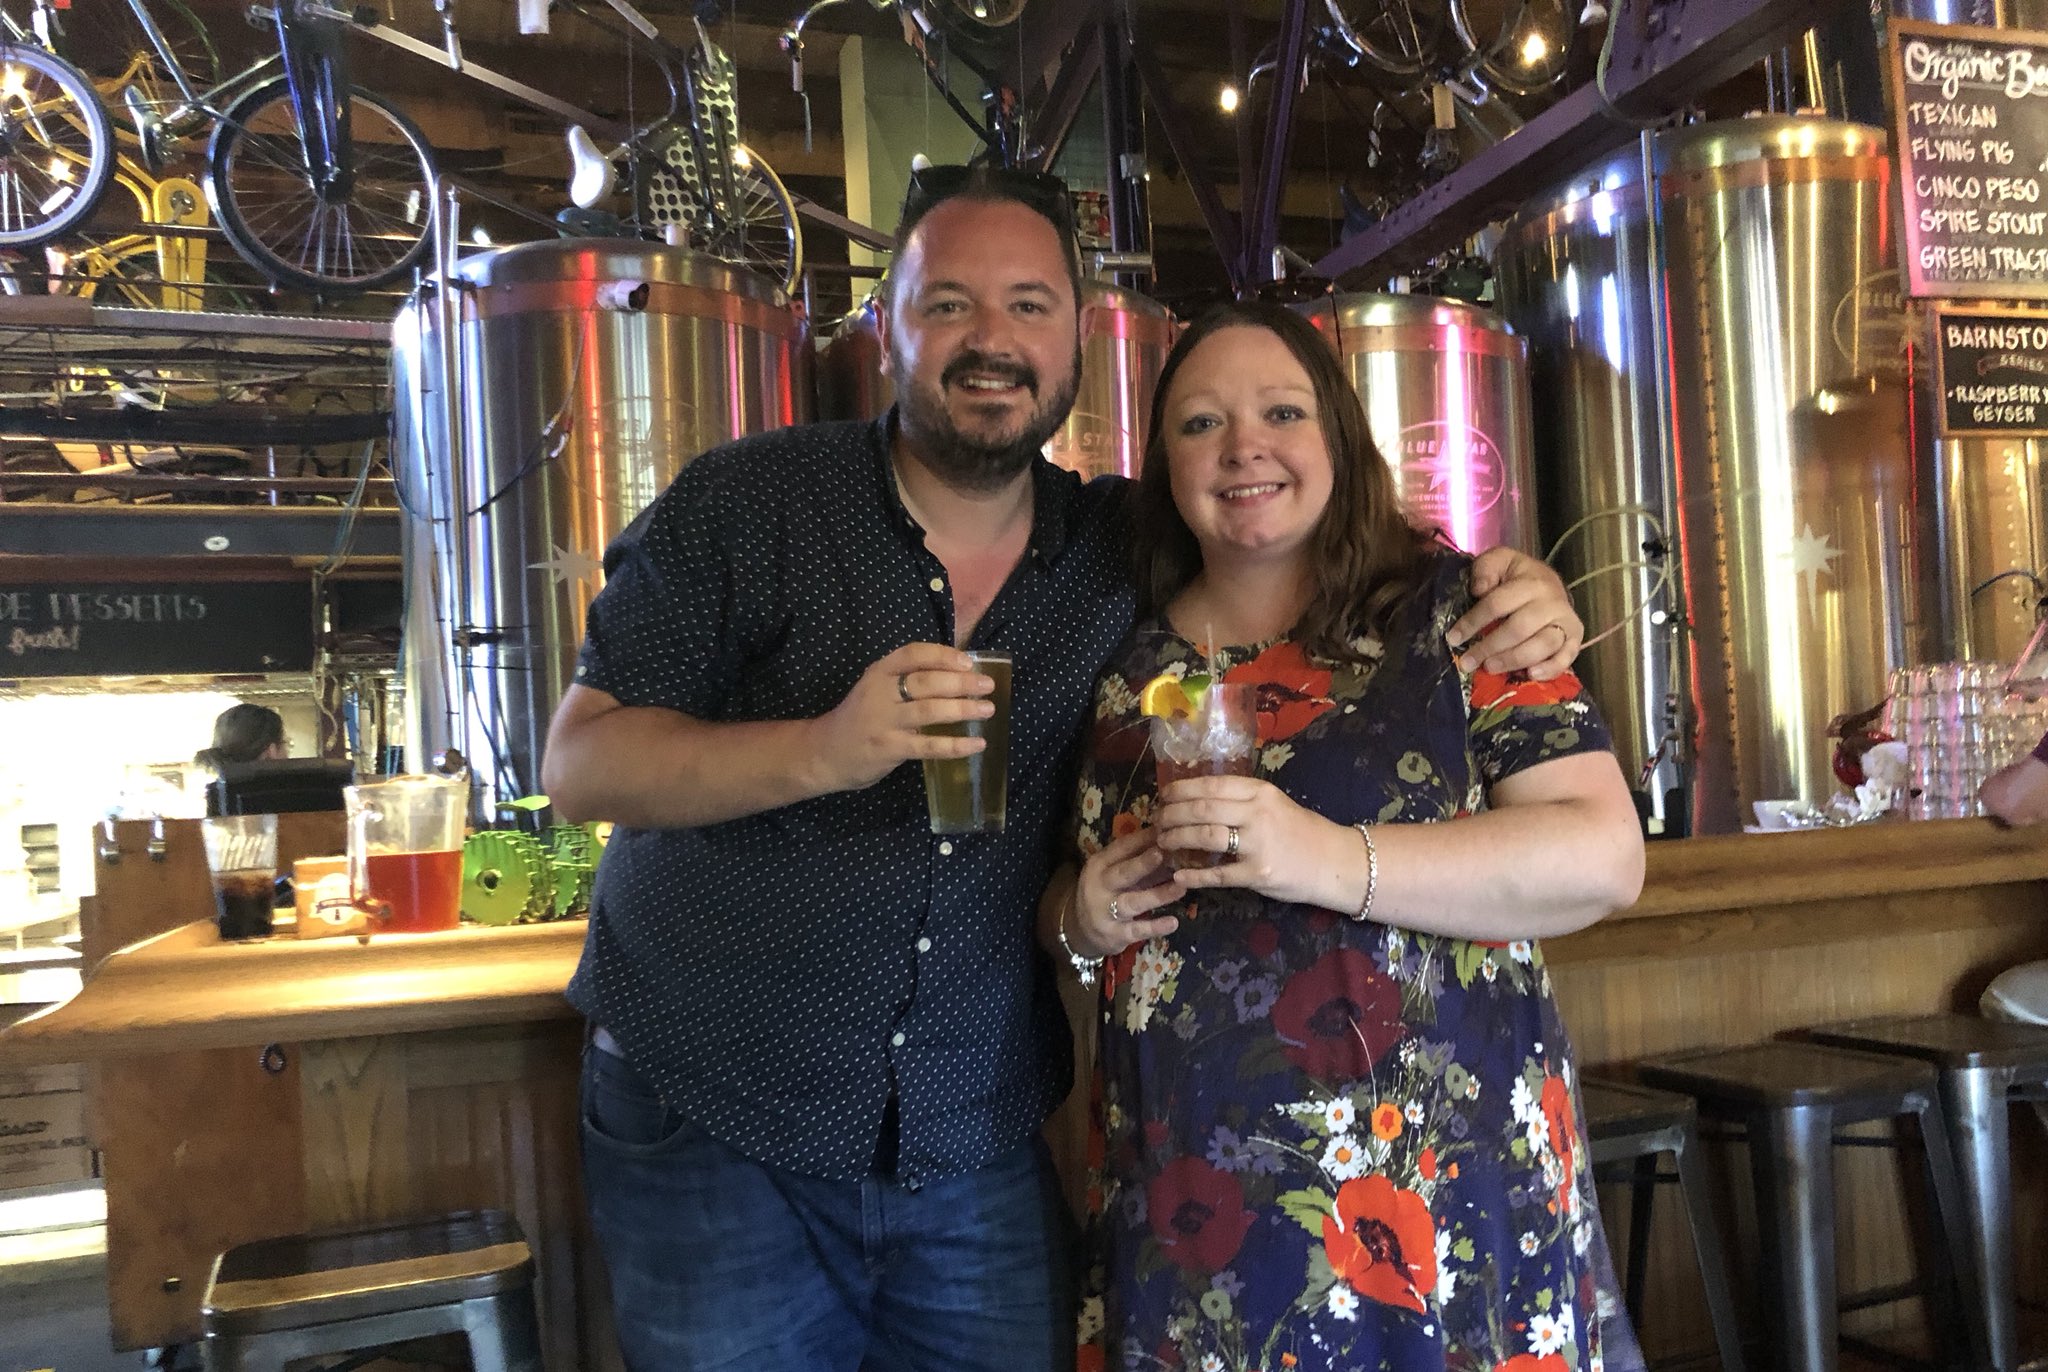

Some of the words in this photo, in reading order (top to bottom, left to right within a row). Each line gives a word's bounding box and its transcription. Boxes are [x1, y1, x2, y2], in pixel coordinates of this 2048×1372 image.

[1904, 41, 2005, 101] Organic
[1909, 101, 1998, 129] TEXICAN
[1911, 136, 1976, 163] FLYING
[1981, 139, 2015, 165] PIG
[1916, 174, 1980, 199] CINCO
[1985, 176, 2040, 203] PESO
[1919, 208, 1982, 233] SPIRE
[1985, 210, 2048, 236] STOUT
[1920, 245, 1987, 270] GREEN
[1989, 245, 2048, 272] TRACT
[1946, 323, 2048, 350] BARNSTO
[1955, 384, 2048, 405] RASPBERRY
[1972, 404, 2036, 422] GEYSER
